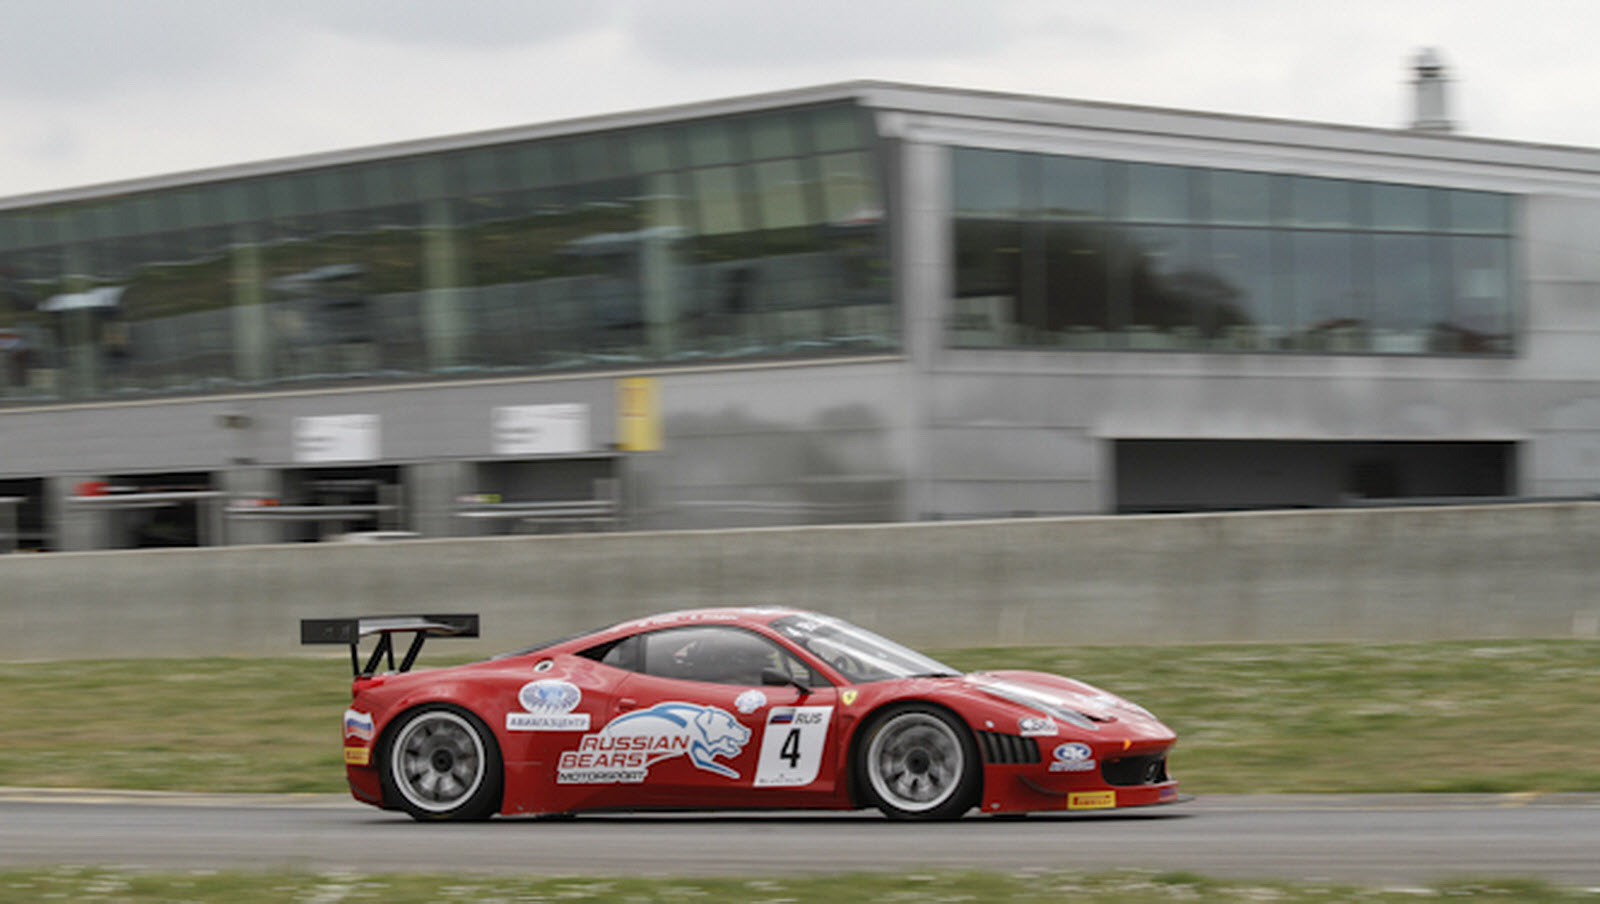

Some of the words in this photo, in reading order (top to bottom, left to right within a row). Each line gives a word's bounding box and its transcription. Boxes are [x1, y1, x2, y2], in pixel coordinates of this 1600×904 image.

[795, 713, 823, 724] RUS
[582, 735, 690, 751] RUSSIAN
[780, 728, 800, 769] 4
[561, 753, 643, 768] BEARS
[560, 771, 645, 780] MOTORSPORT
